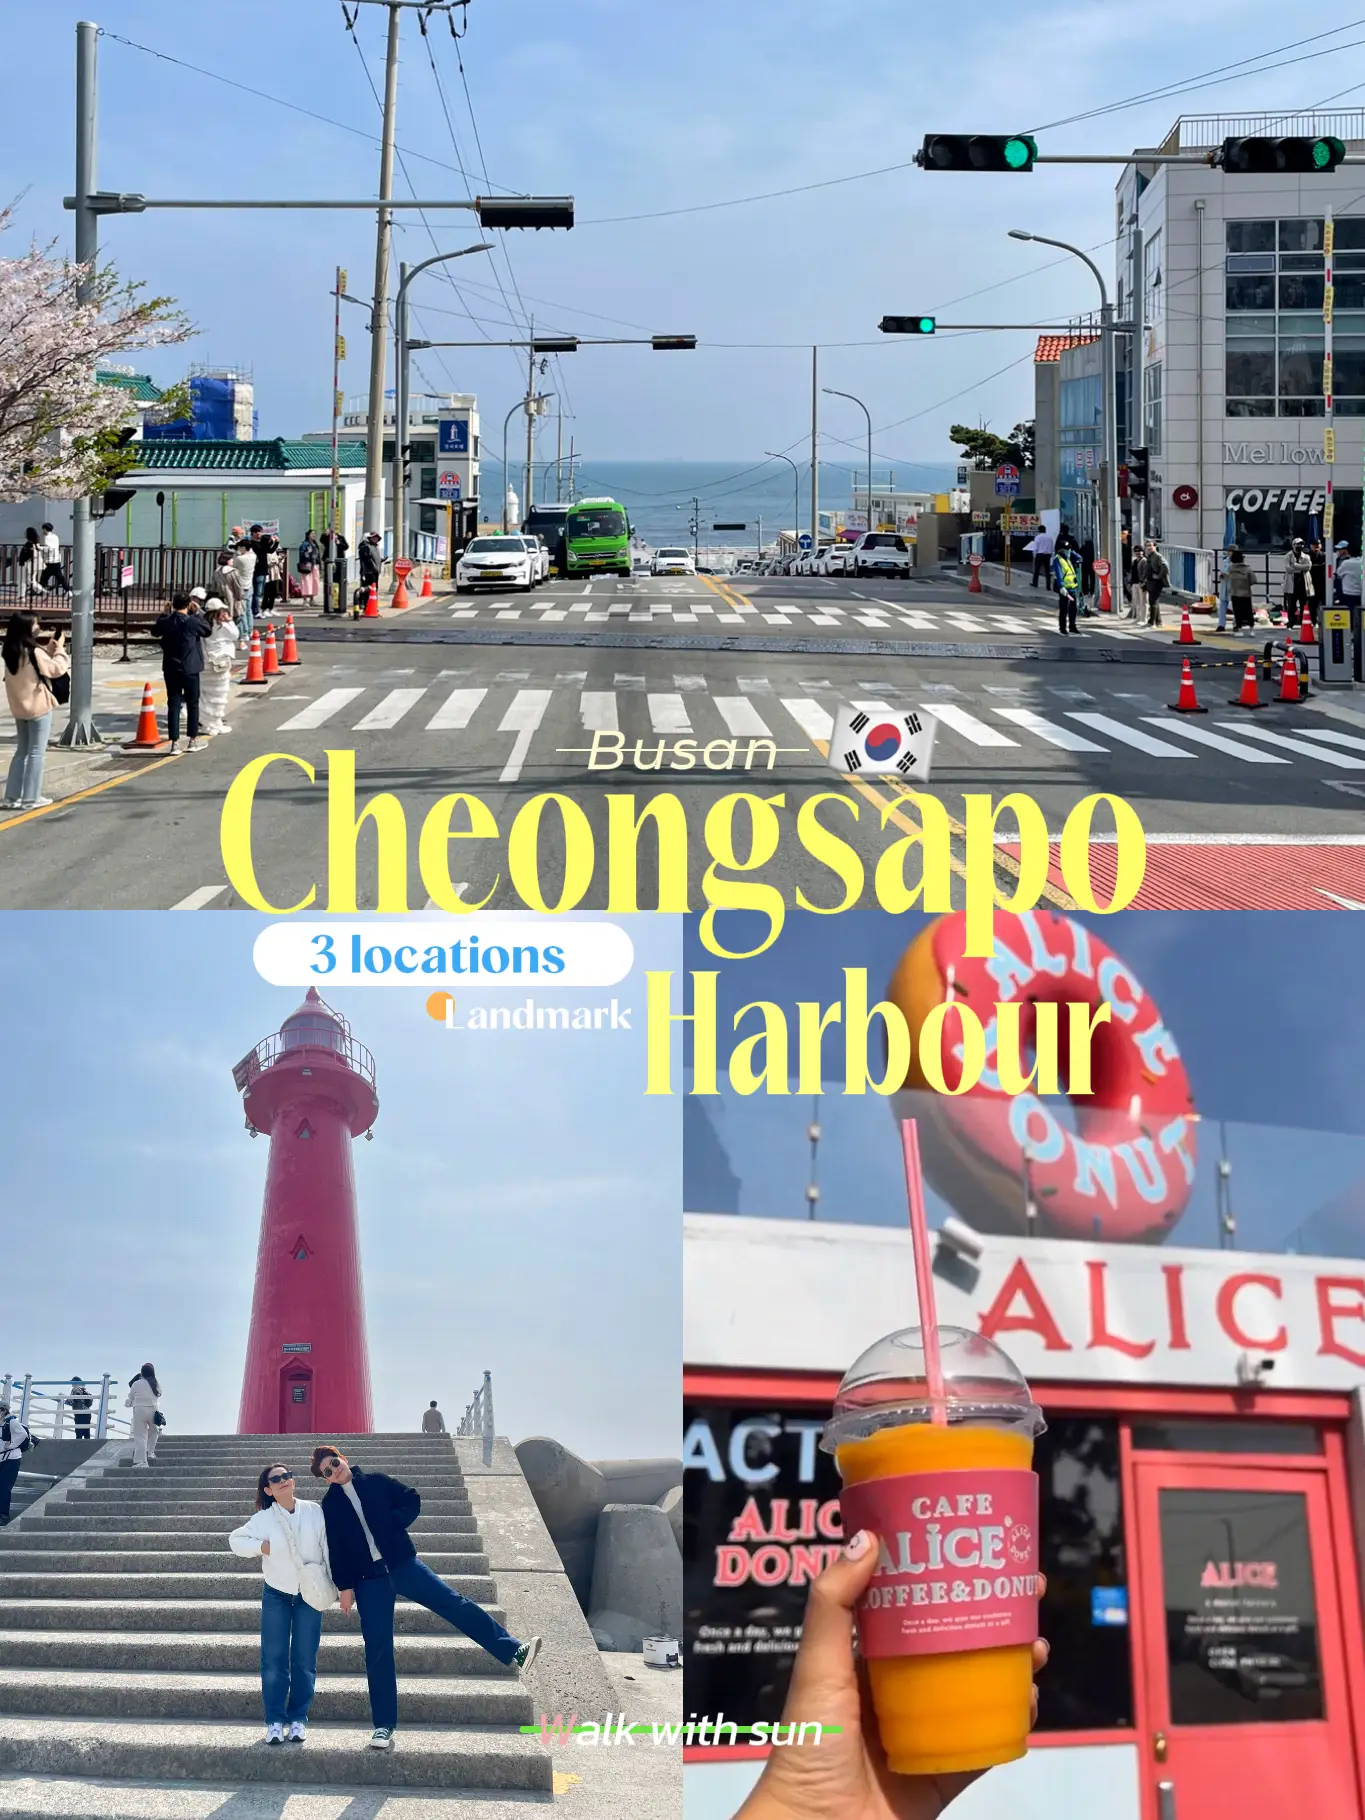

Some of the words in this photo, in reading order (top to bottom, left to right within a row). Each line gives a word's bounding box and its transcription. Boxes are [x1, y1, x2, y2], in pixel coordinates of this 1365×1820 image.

[1223, 442, 1326, 464] Mellow
[1226, 488, 1326, 513] COFFEE
[977, 1256, 1365, 1369] ALICE
[726, 1496, 845, 1543] ALIC
[912, 1493, 993, 1520] CAFE
[713, 1544, 843, 1587] DON
[872, 1523, 1007, 1577] ALICE
[862, 1574, 1039, 1609] OFFEE&DONU
